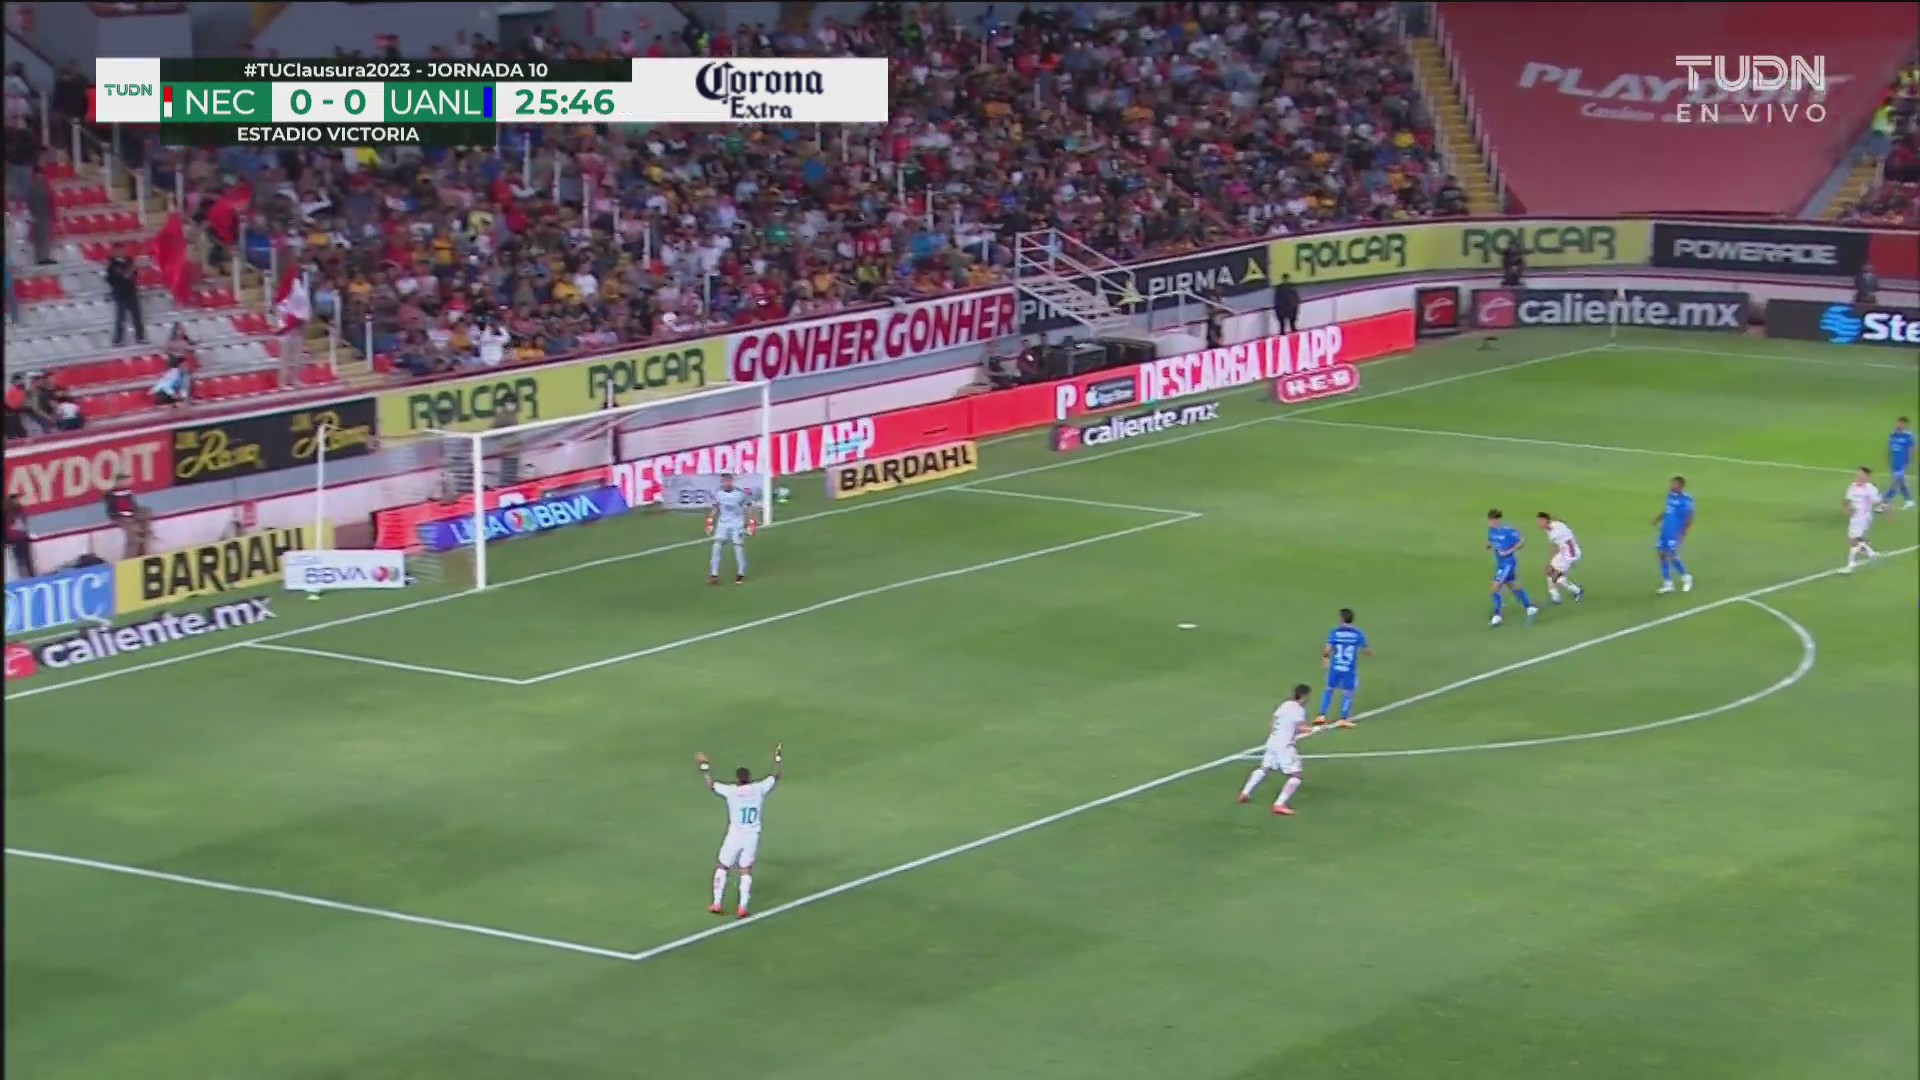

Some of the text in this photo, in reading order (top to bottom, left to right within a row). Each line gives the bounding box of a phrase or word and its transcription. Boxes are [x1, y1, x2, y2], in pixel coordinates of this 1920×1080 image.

[1295, 232, 1407, 276] ROLCAR
[1462, 225, 1616, 263] ROLCAR
[1673, 238, 1838, 265] POWERADE
[1149, 265, 1235, 298] PIRMA
[1518, 293, 1740, 327] caliente.mx
[732, 293, 1016, 382] GONHER GONHER
[588, 348, 705, 399] ROLCAR
[1139, 341, 1263, 403] DESCARGA
[1265, 334, 1292, 378] LA
[1296, 325, 1342, 371] APP
[1082, 403, 1220, 447] caliente.mx
[839, 445, 972, 491] BARDAHL
[532, 494, 600, 528] BBVA
[41, 596, 276, 668] caliente.mx
[740, 807, 757, 824] 10
